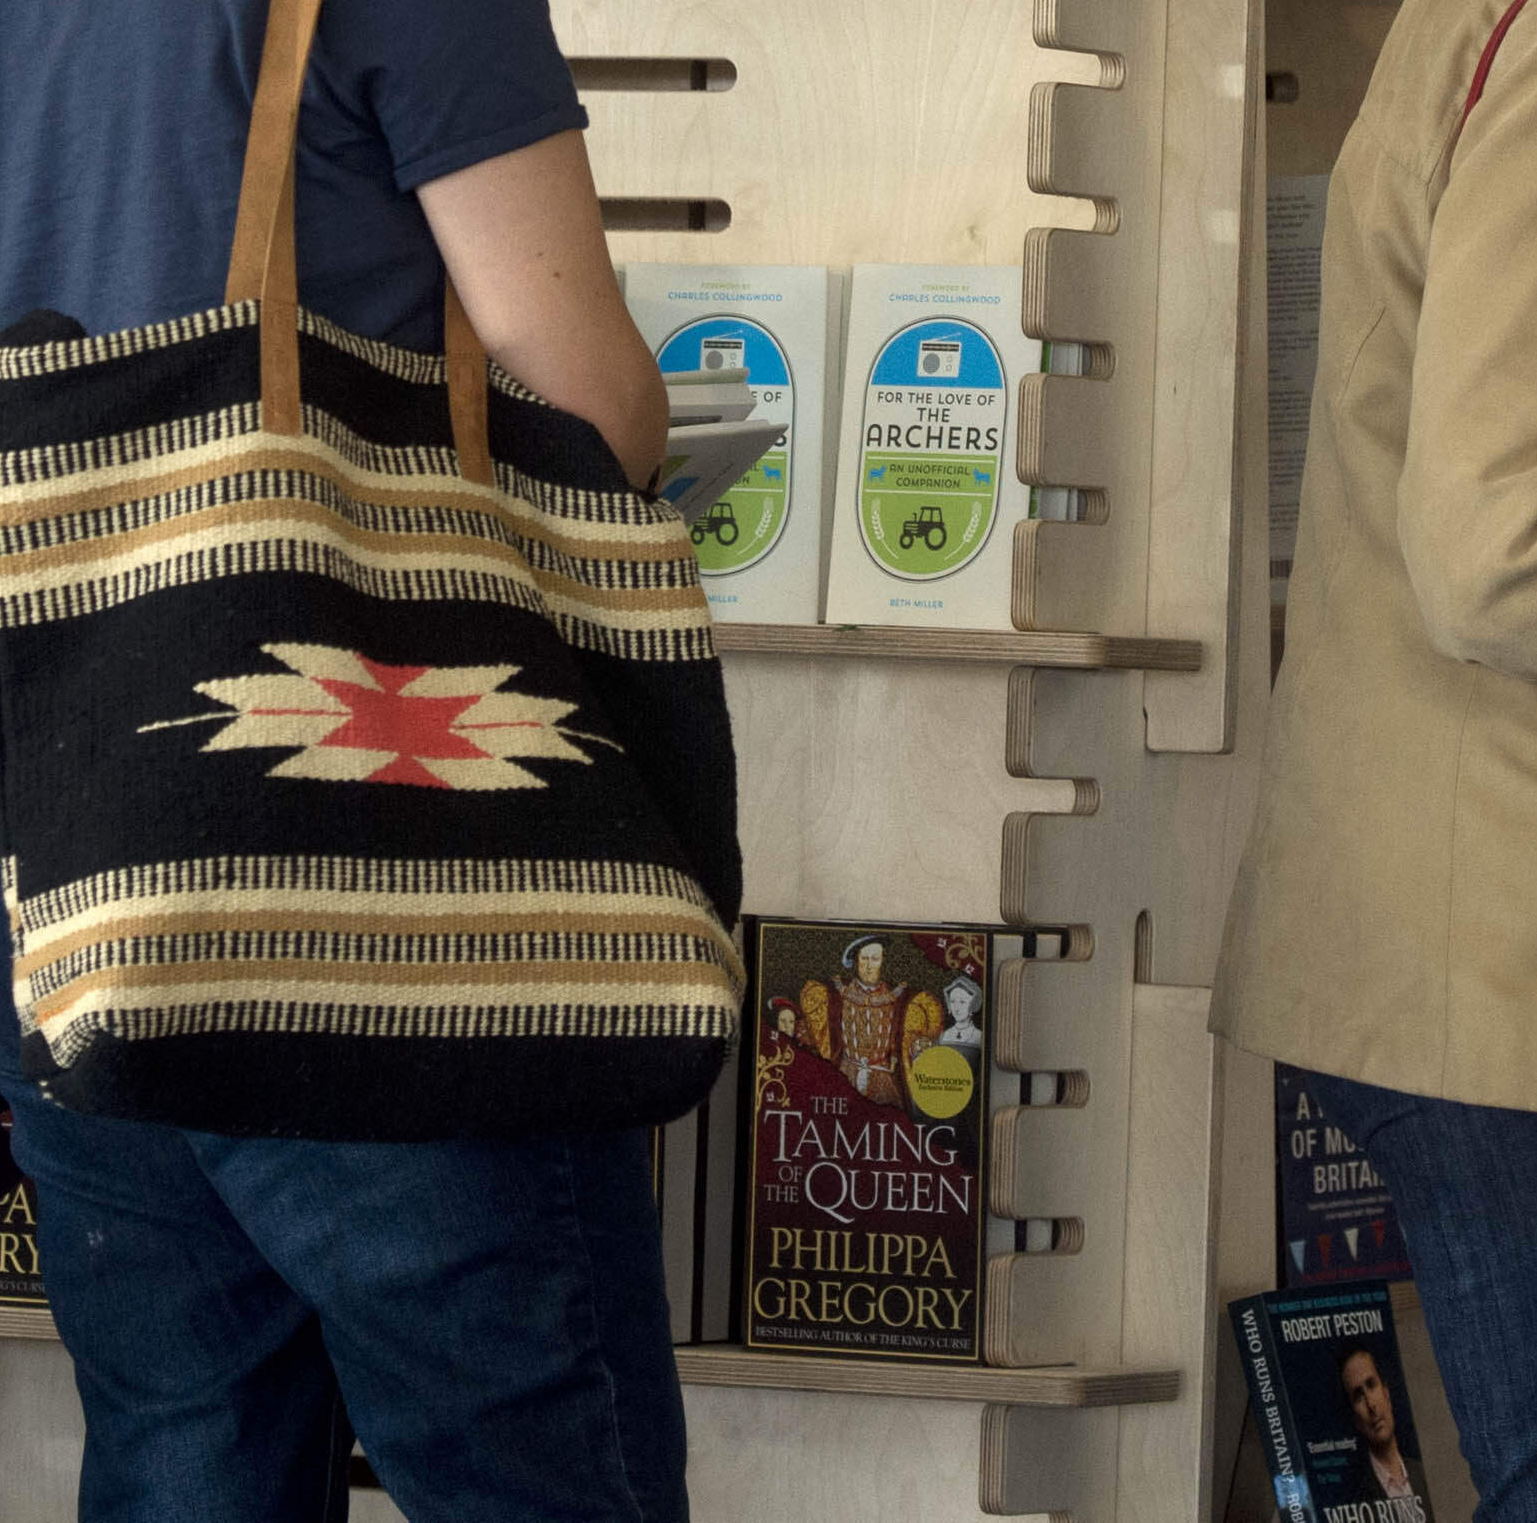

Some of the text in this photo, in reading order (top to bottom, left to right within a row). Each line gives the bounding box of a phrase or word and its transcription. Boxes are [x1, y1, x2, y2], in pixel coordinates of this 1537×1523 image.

[668, 291, 783, 302] CHARLES COLLINGWOOD
[888, 293, 1001, 305] CHARLES COLLINGWOOD
[763, 391, 783, 403] OF
[877, 391, 996, 407] FOR THE LOVE OF
[916, 407, 951, 423] THE
[865, 423, 999, 452] ARCHERS
[889, 463, 971, 476] AN UNOFFICIAL
[895, 476, 961, 489] COMPANION
[889, 598, 944, 609] BETH MILLER
[810, 1096, 848, 1116] THE
[1296, 1091, 1311, 1121] A
[763, 1109, 958, 1166] TAMING
[1291, 1128, 1319, 1159] OF
[778, 1165, 803, 1182] OF
[1313, 1160, 1387, 1195] BRITA
[763, 1184, 799, 1203] THE
[804, 1161, 974, 1224] QUEEN
[769, 1227, 955, 1279] PHILIPPA
[753, 1277, 974, 1331] GREGORY
[1281, 1310, 1384, 1343] ROBERT PESTON
[755, 1326, 817, 1340] BESTSELLING
[820, 1330, 863, 1344] AUTHOR
[864, 1333, 878, 1344] OF
[879, 1334, 901, 1345] THE
[936, 1337, 972, 1350] CURSE
[1241, 1308, 1296, 1484] WHO RUNS BRITAIN?
